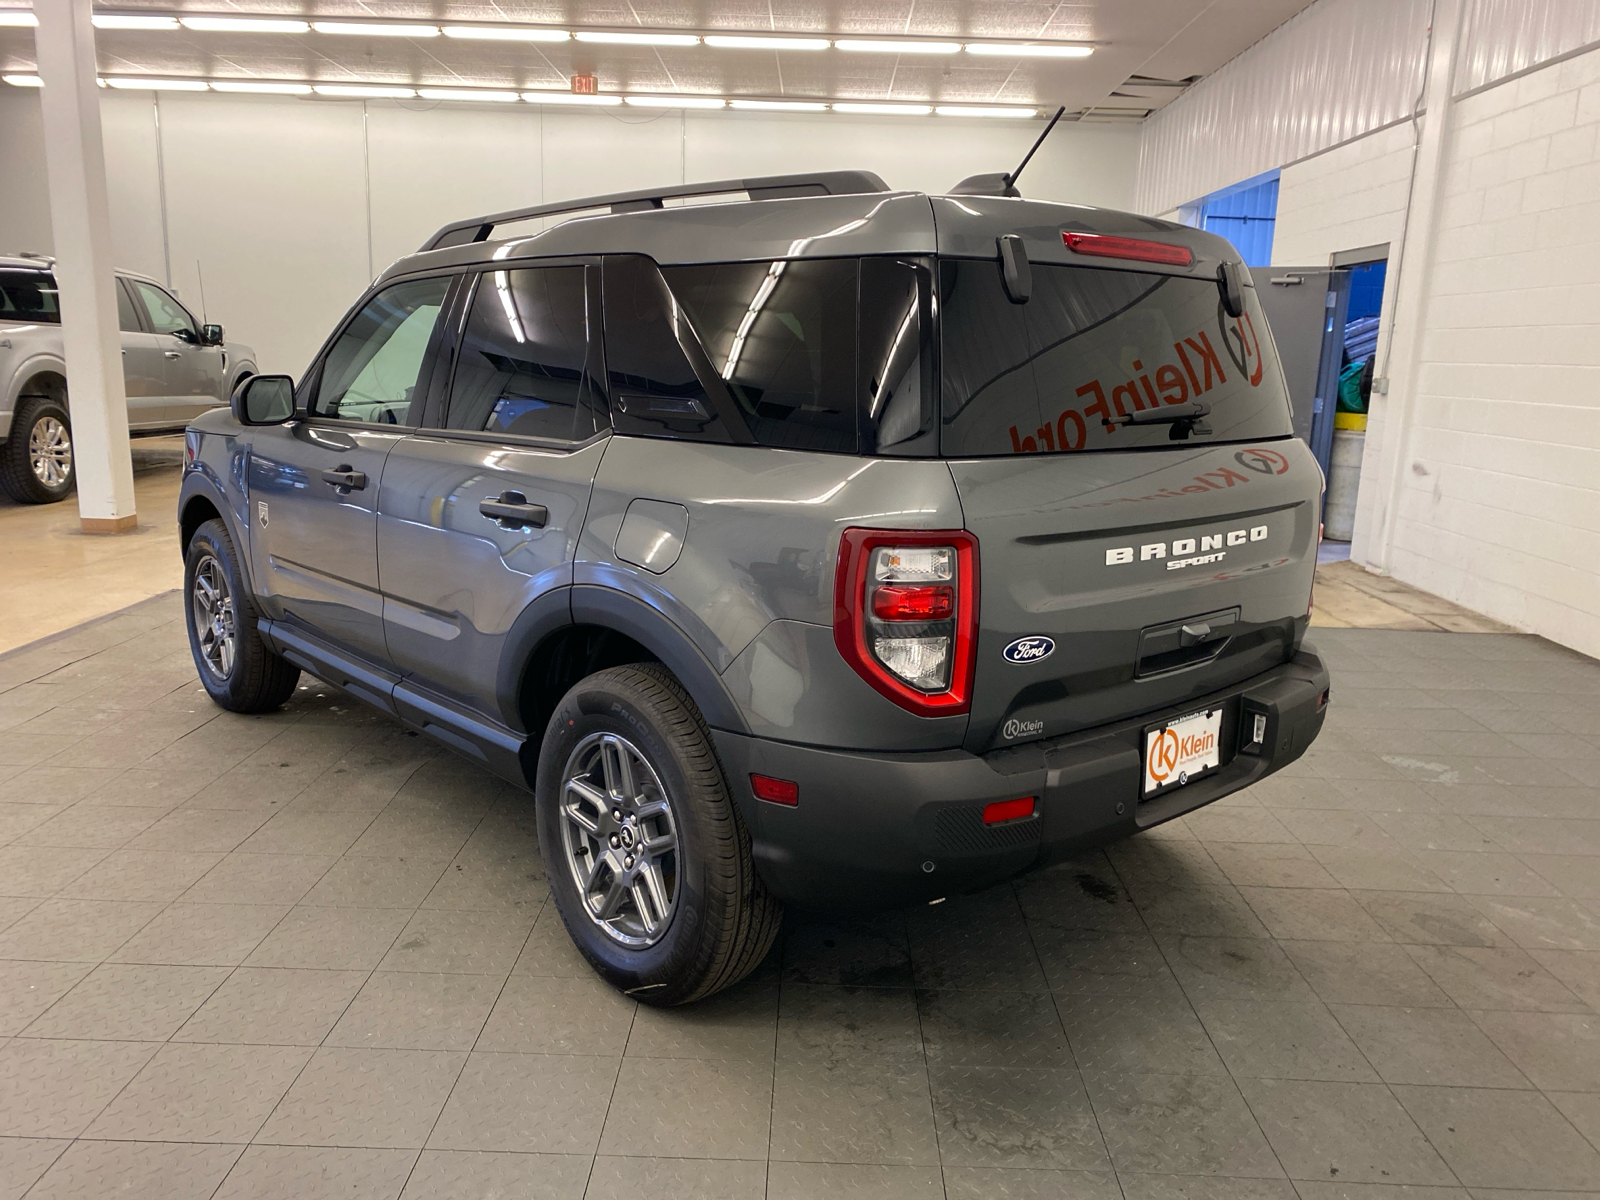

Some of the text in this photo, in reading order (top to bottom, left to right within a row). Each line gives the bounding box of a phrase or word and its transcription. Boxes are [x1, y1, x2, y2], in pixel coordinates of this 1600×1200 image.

[575, 76, 595, 93] EXIT
[1105, 525, 1268, 566] BRONCO
[1166, 552, 1226, 570] SPORT
[1013, 640, 1047, 660] Ford
[1020, 720, 1044, 732] Klein
[1180, 730, 1214, 760] Klein
